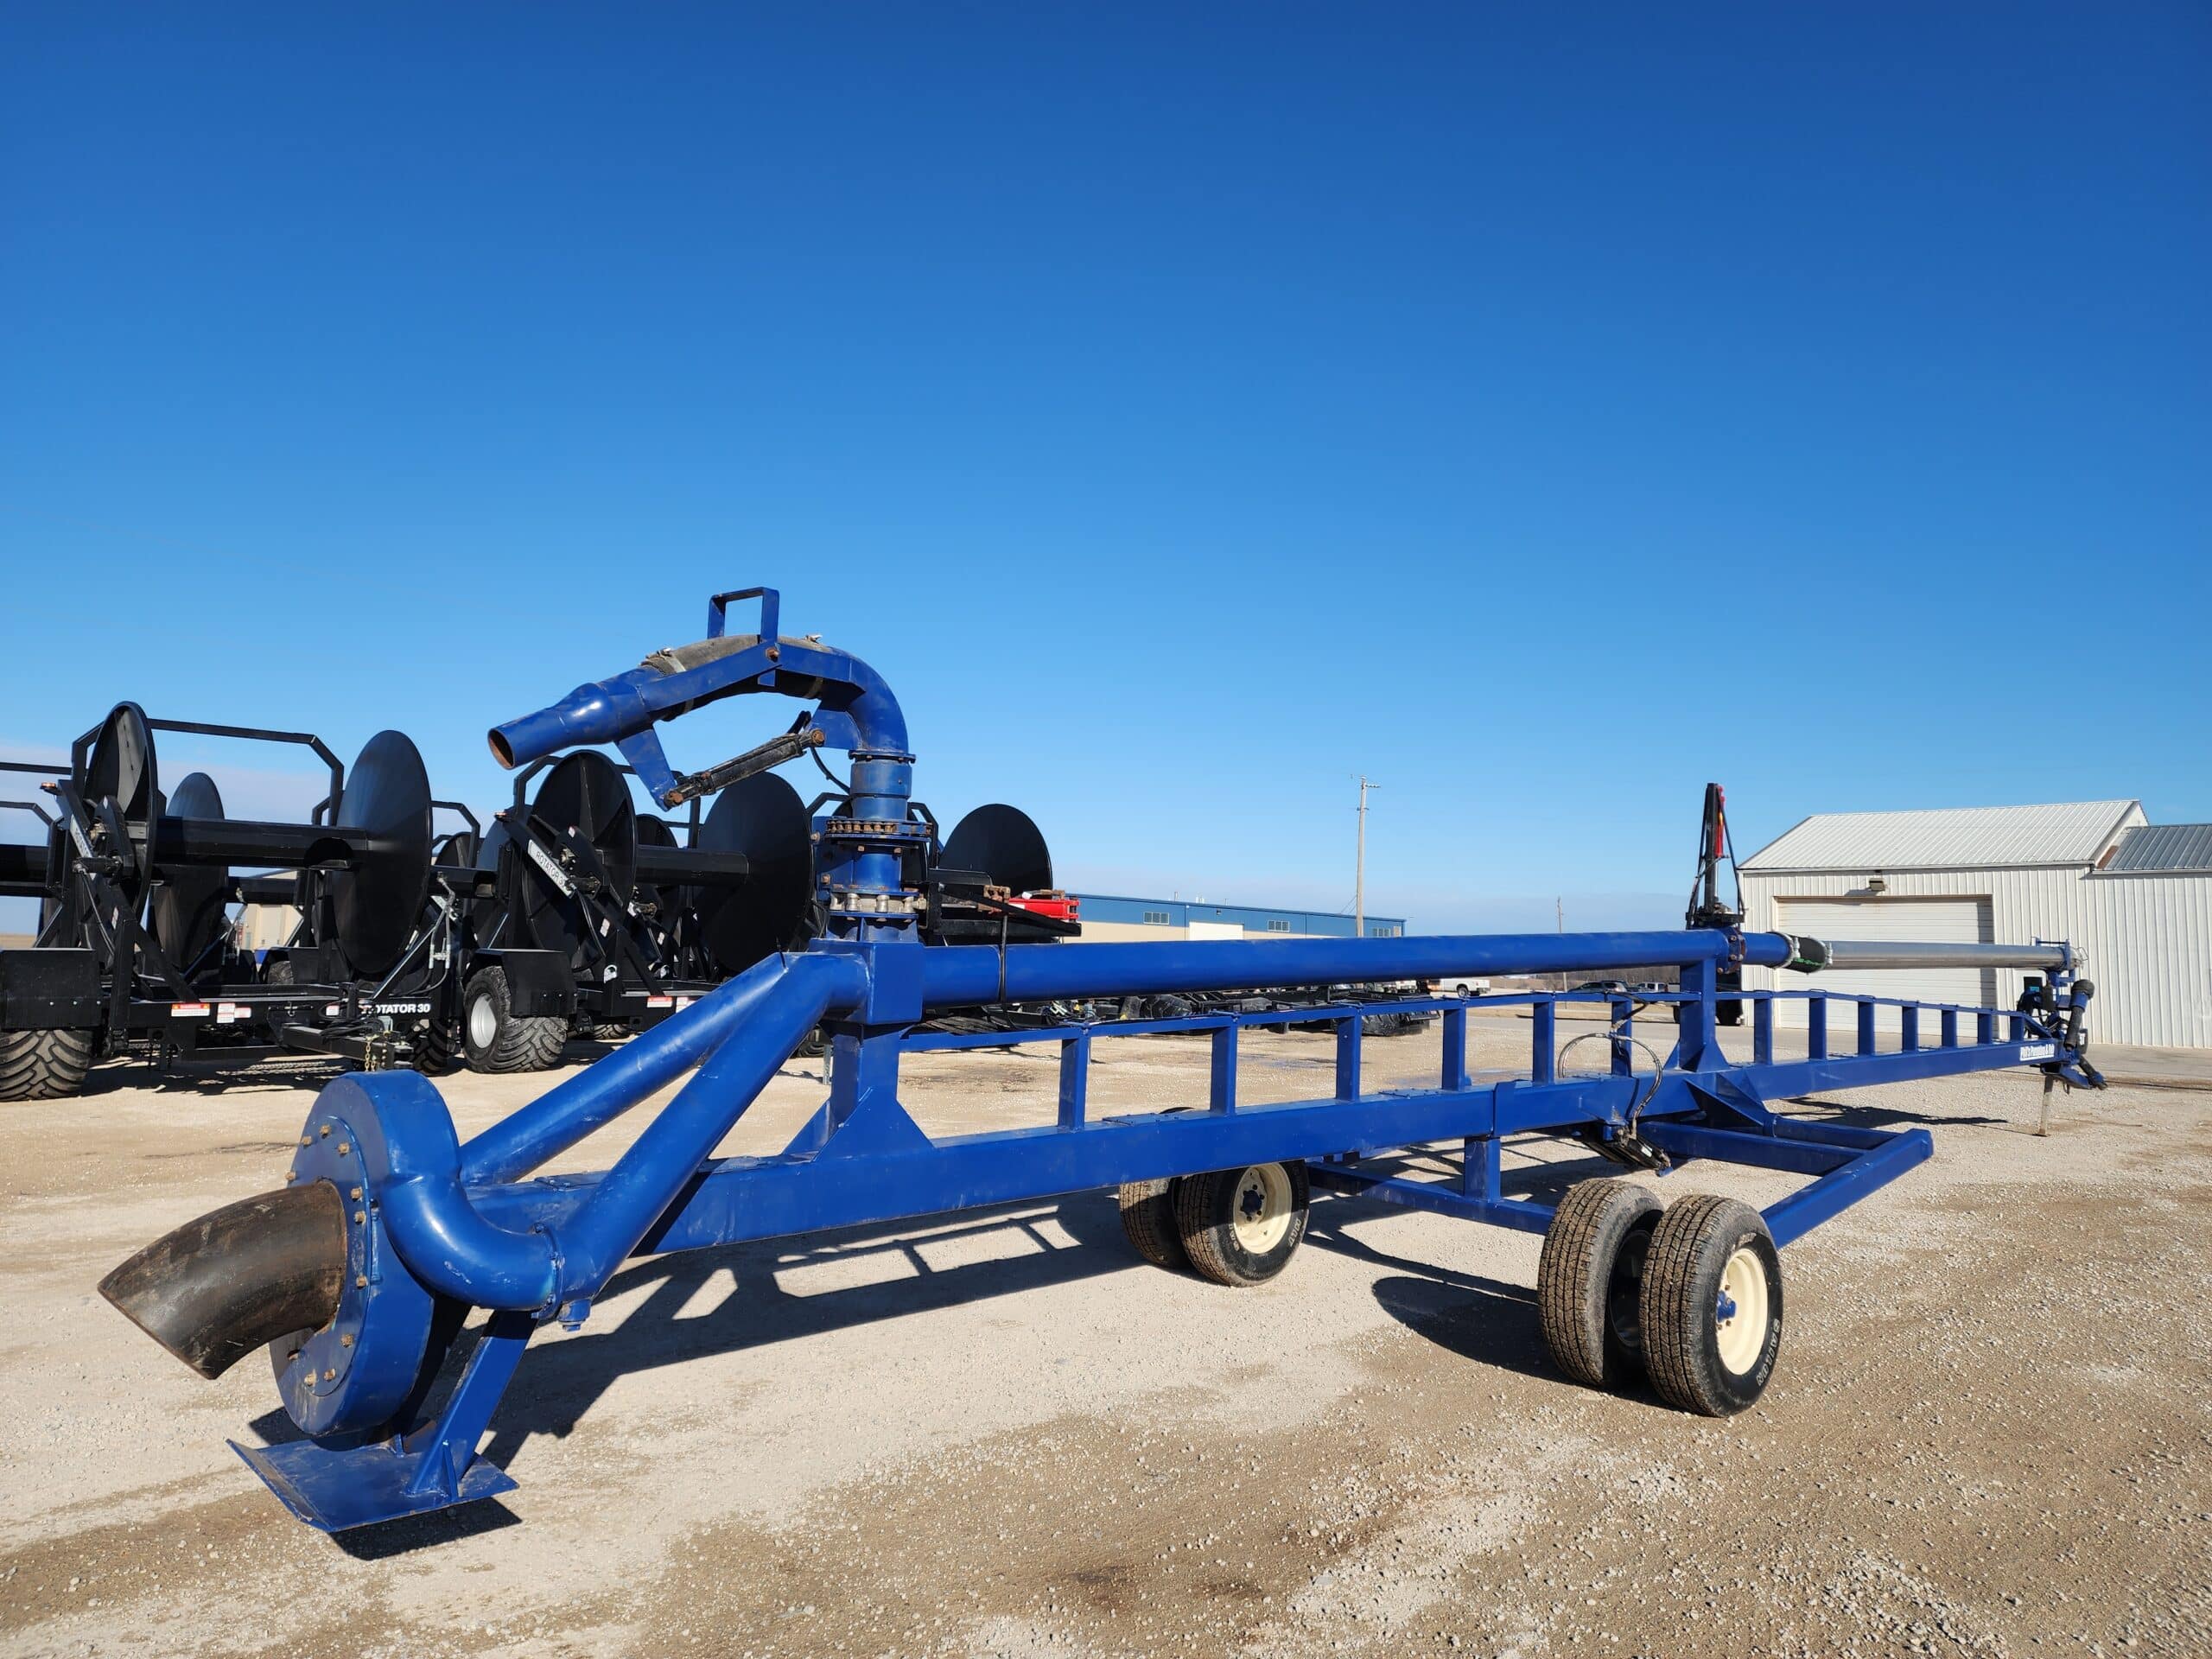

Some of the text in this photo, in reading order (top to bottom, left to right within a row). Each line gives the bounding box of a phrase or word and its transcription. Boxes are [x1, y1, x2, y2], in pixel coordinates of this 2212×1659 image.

[537, 851, 560, 880] ROTATOR
[417, 1003, 430, 1013] 30
[1756, 1319, 1780, 1387] SAILUN
